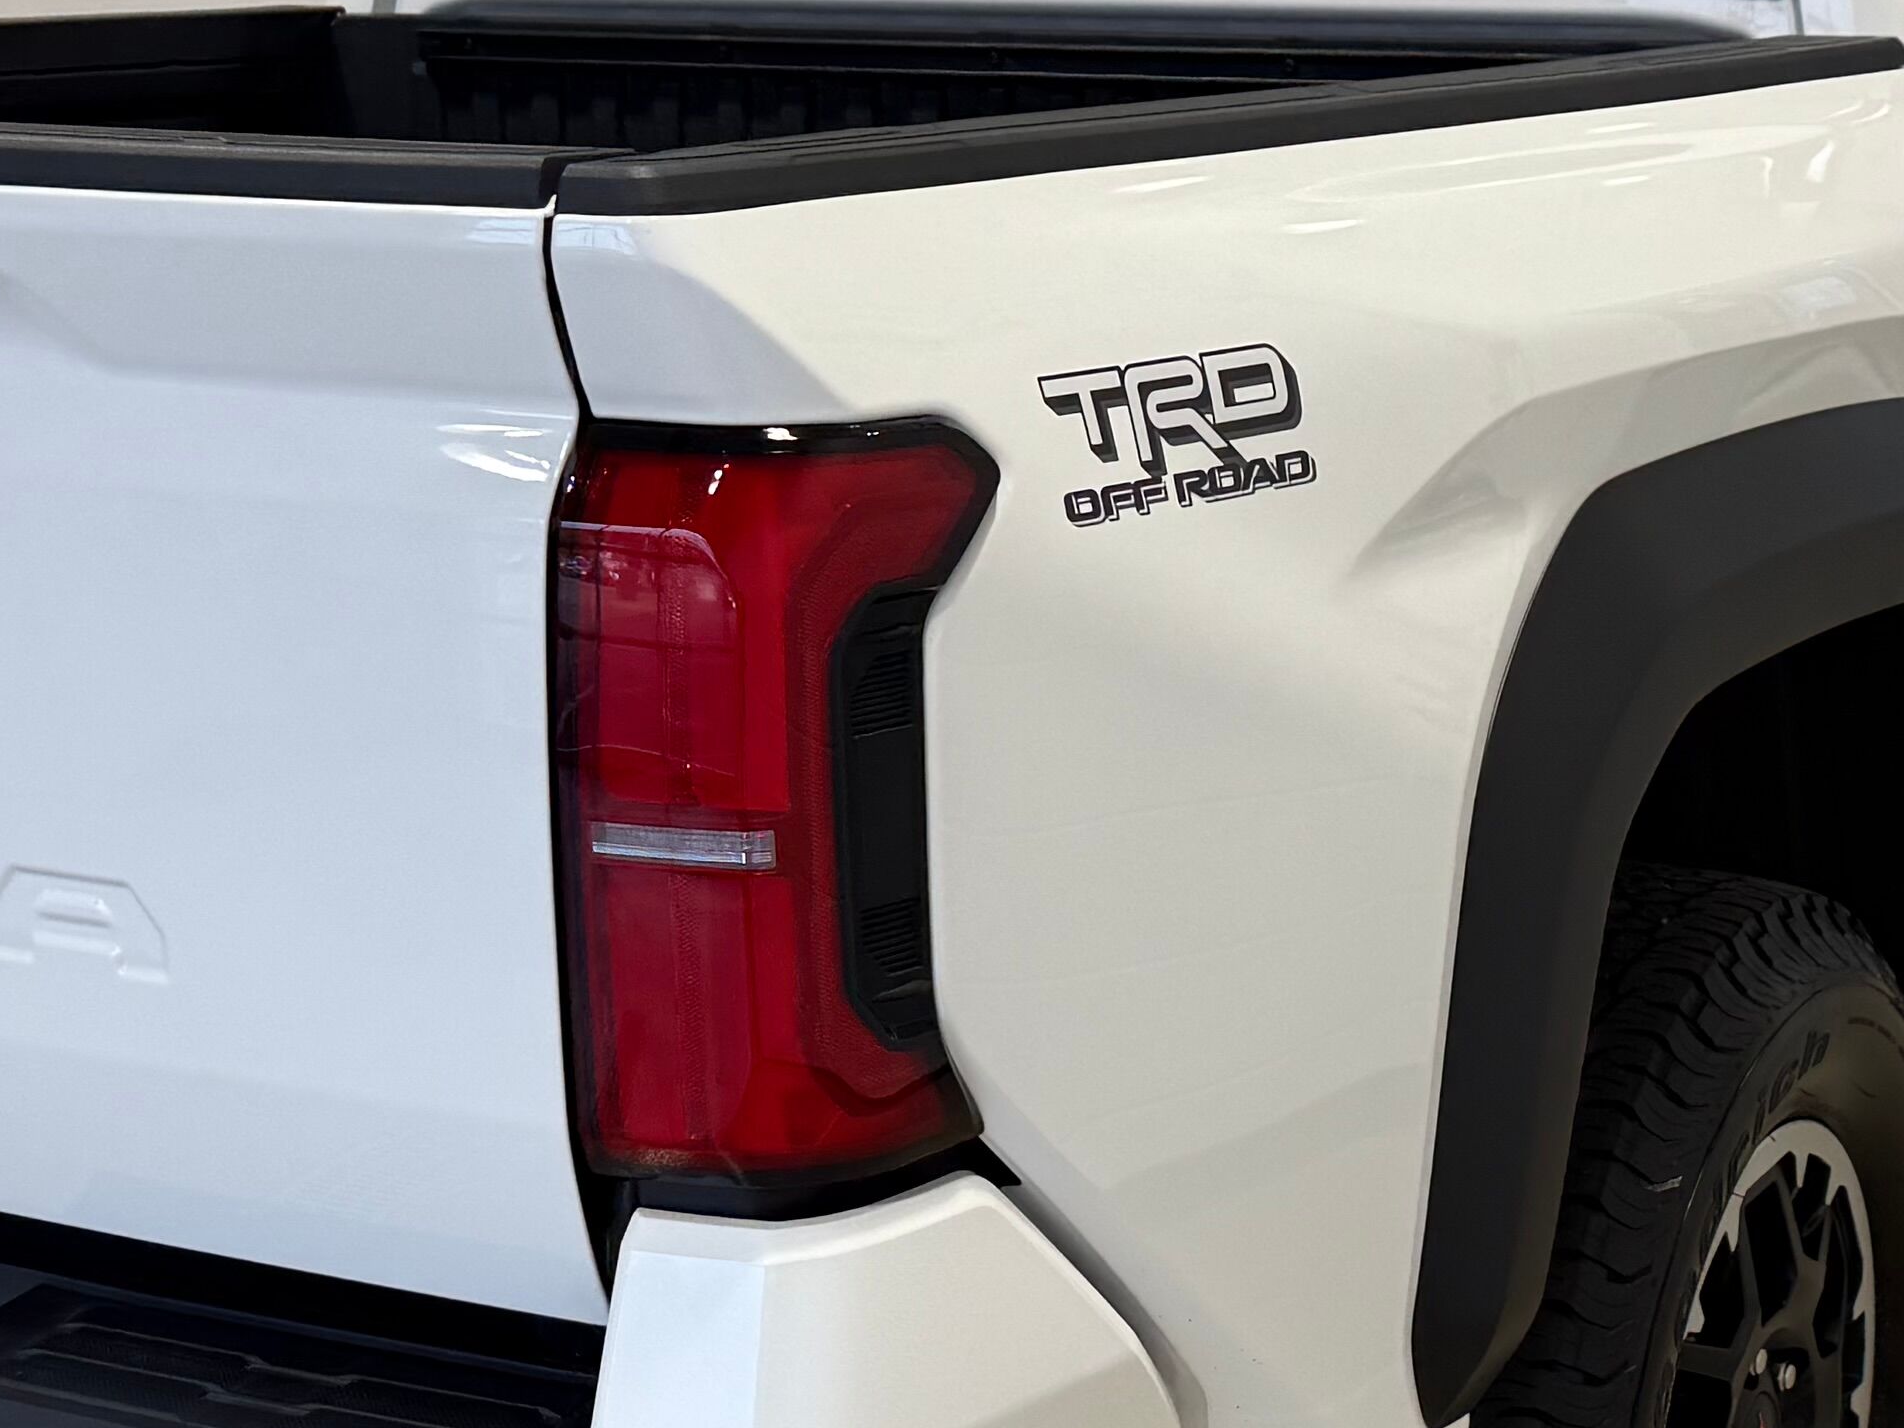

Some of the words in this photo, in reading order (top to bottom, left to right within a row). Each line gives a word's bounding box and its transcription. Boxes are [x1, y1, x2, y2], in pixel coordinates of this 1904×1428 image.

[1037, 342, 1303, 478] TRD
[1063, 477, 1169, 528] OFF
[1173, 449, 1317, 508] ROAD
